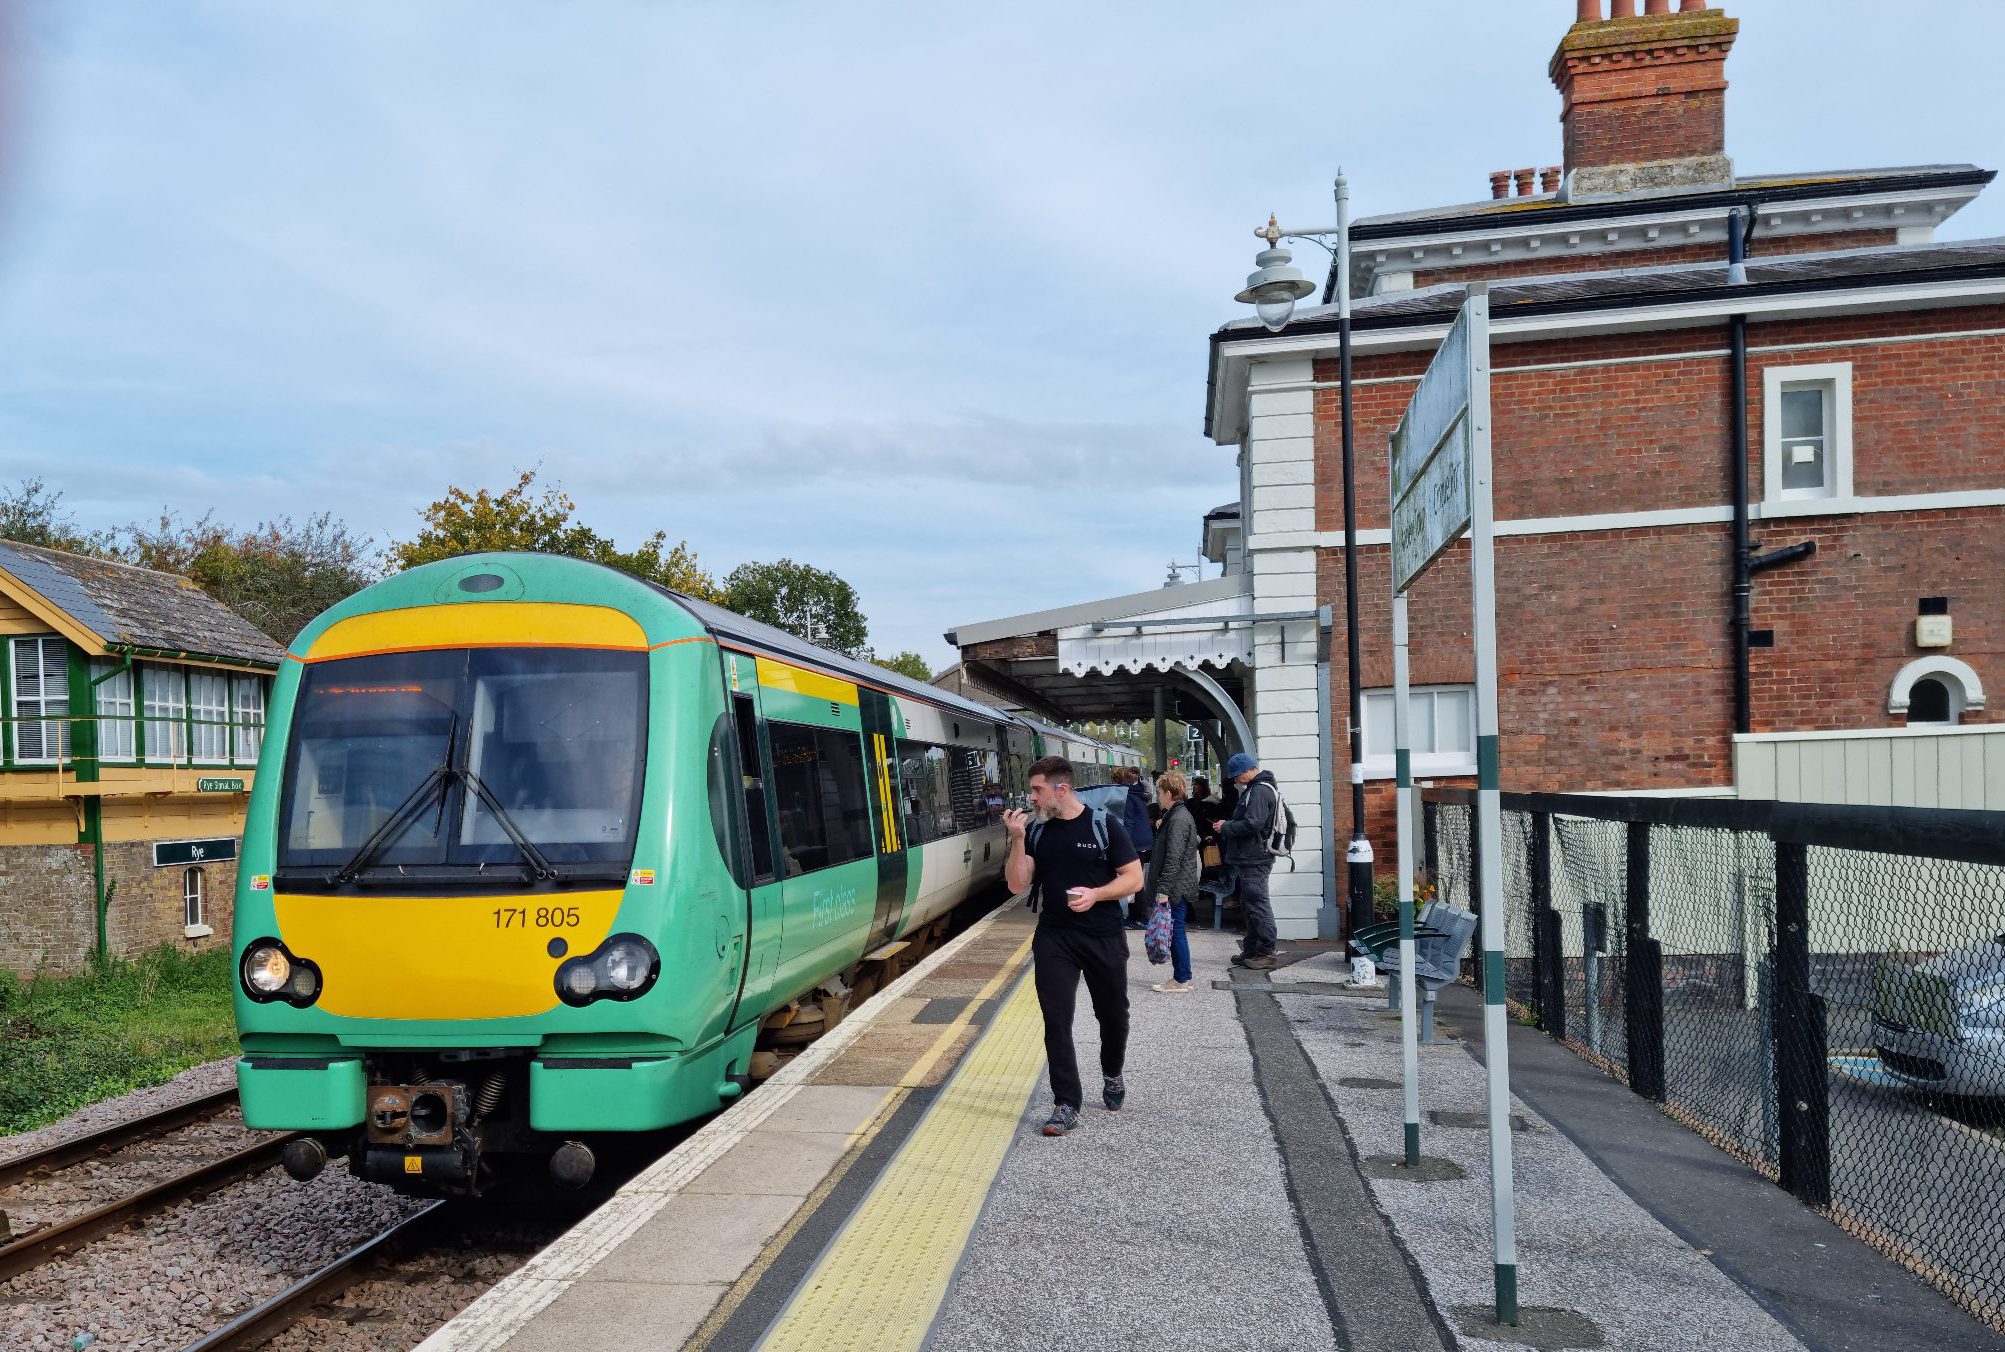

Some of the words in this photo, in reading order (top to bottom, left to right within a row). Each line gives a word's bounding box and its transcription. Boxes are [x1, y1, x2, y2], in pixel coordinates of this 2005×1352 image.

[1192, 728, 1200, 738] 2
[203, 780, 213, 791] Rye
[191, 845, 204, 861] Rye
[812, 887, 834, 929] First
[492, 907, 526, 929] 171
[535, 906, 580, 928] 805
